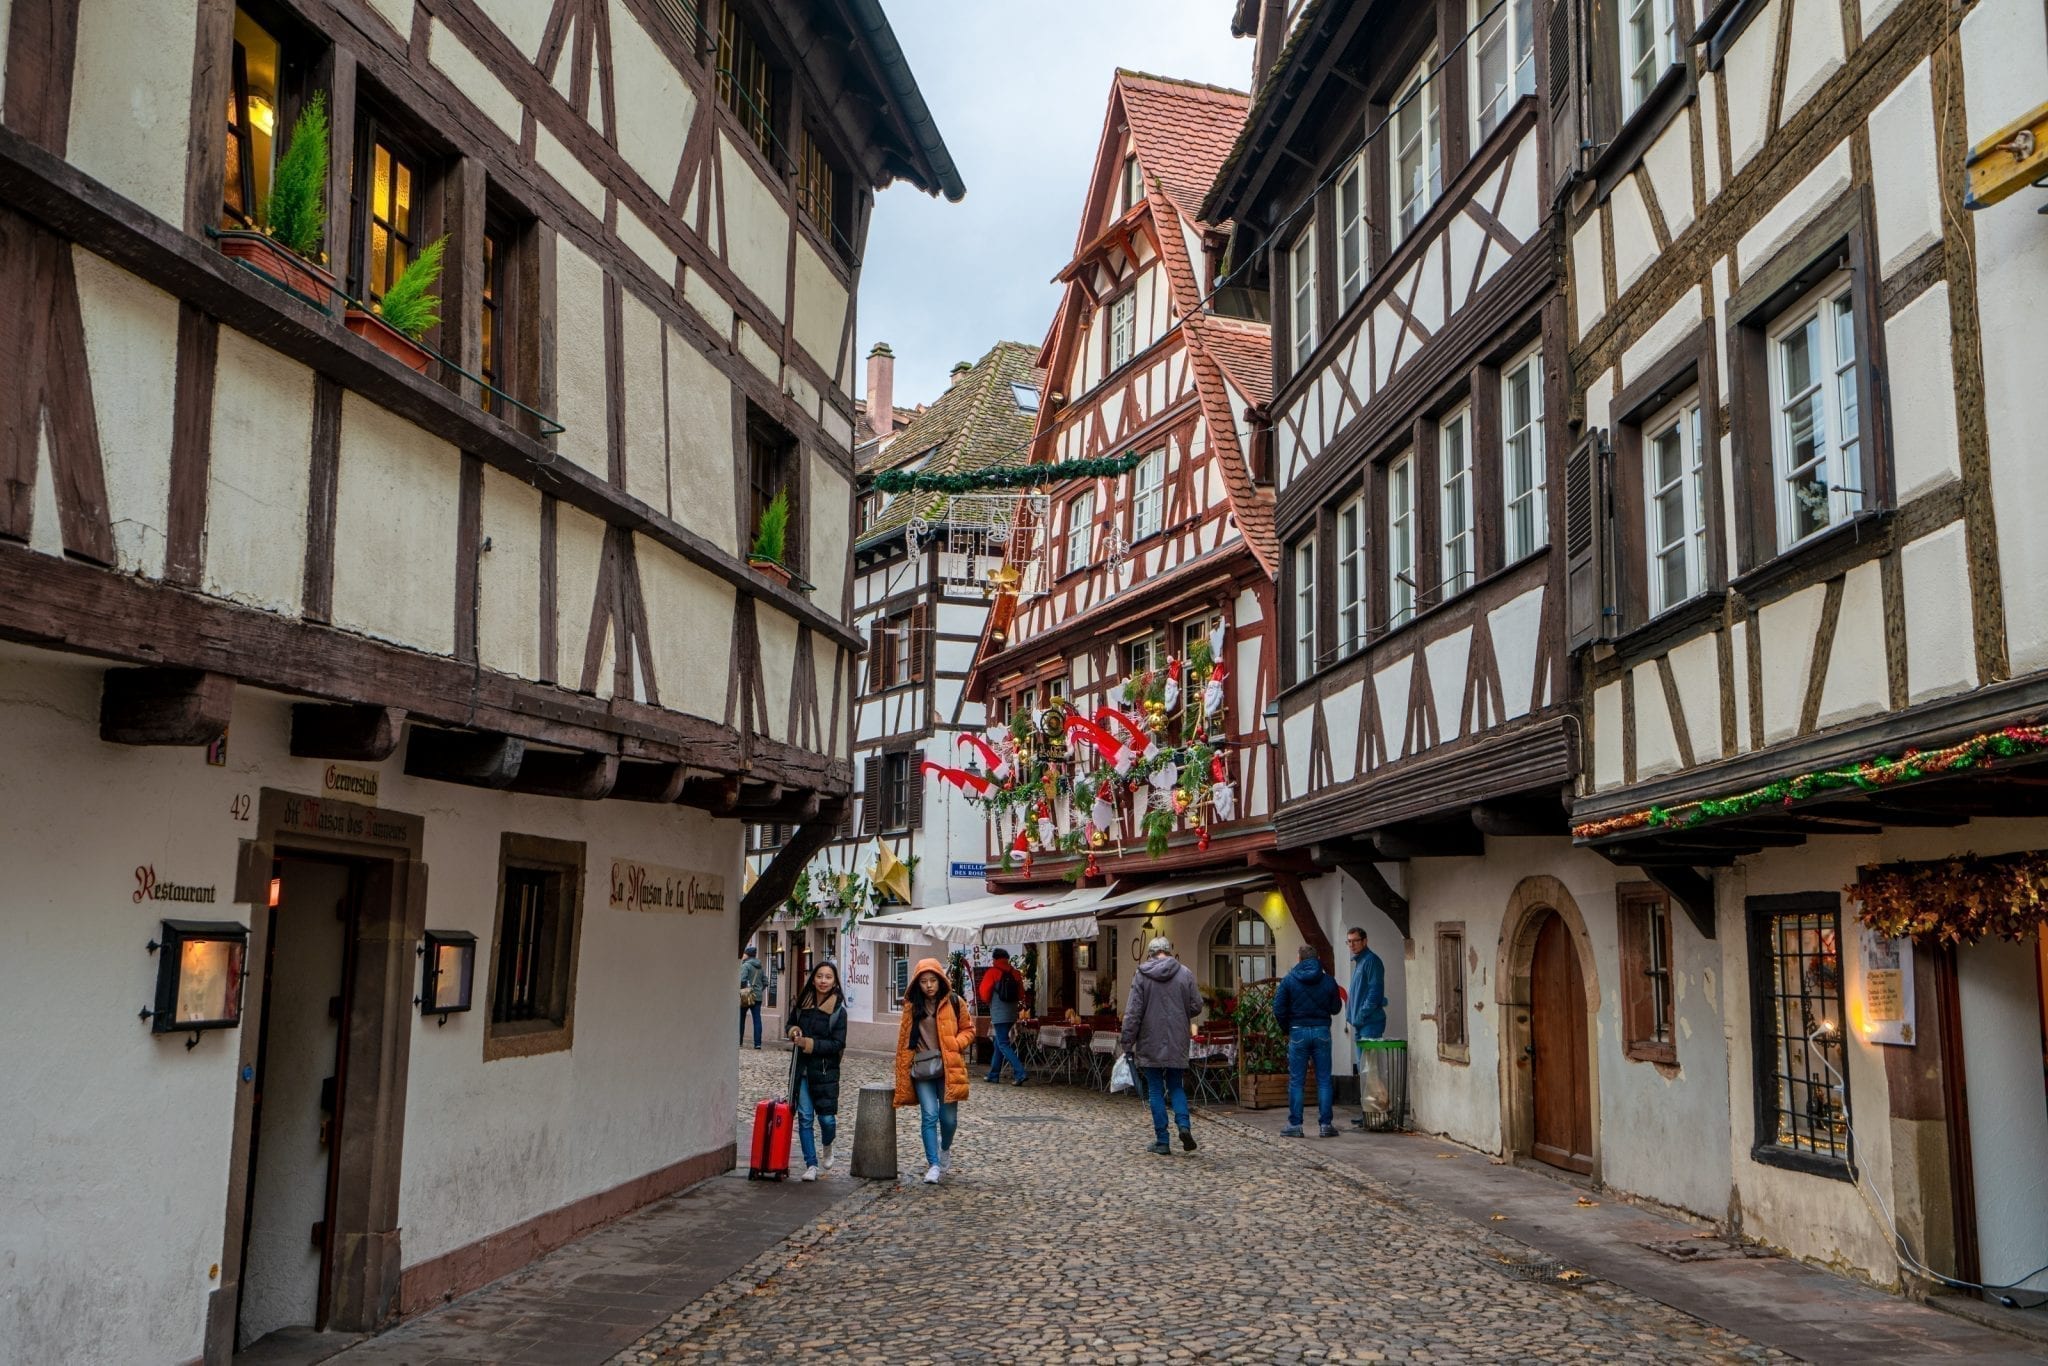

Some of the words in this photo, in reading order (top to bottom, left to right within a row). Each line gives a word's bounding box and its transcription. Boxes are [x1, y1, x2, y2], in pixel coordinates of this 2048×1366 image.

[230, 793, 251, 821] 42
[303, 799, 344, 833] Maison
[347, 809, 363, 835] des
[133, 863, 216, 904] Restaurant
[610, 862, 624, 906] La
[627, 864, 662, 913] Maison
[665, 877, 674, 908] de
[676, 879, 685, 909] la
[847, 964, 870, 987] Alsace
